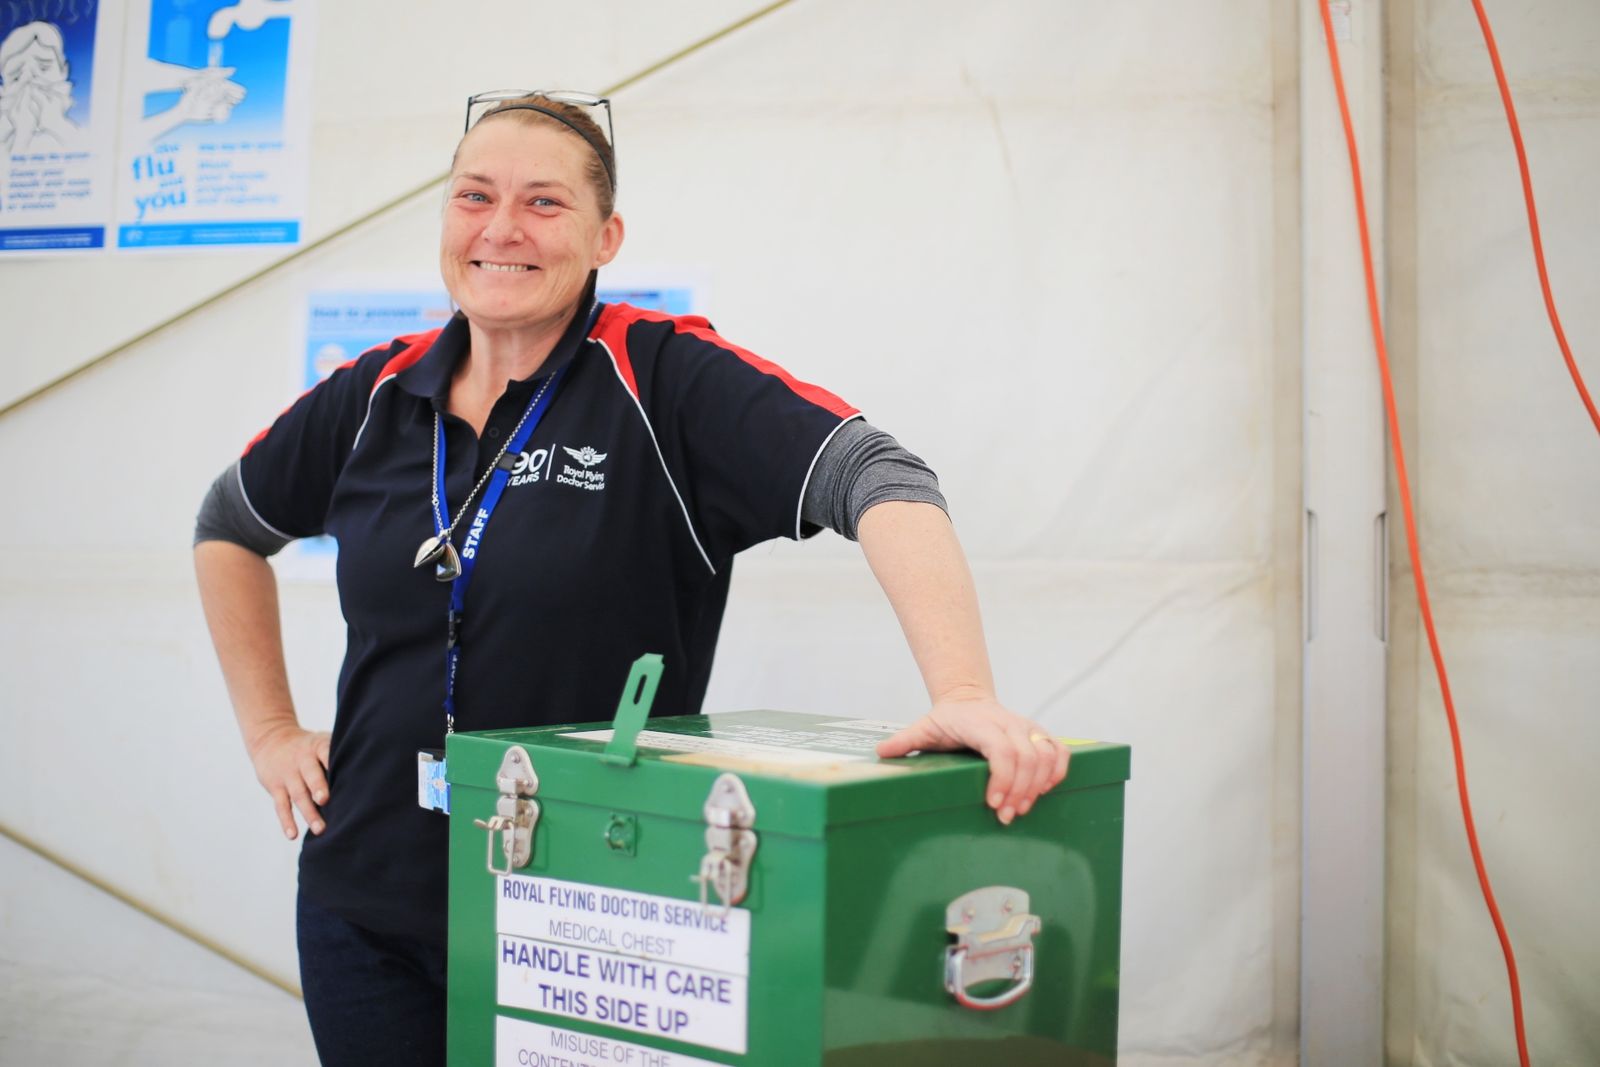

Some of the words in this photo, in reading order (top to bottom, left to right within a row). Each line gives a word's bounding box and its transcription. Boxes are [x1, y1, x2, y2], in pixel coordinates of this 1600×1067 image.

[132, 156, 175, 180] flu
[135, 190, 187, 224] you
[556, 474, 584, 488] Doctor
[563, 465, 585, 479] Royal
[462, 508, 489, 560] STAFF
[503, 879, 545, 905] ROYAL
[549, 886, 596, 912] FLYING
[601, 897, 660, 923] DOCTOR
[664, 904, 729, 934] SERVICE
[549, 919, 617, 947] MEDICAL
[621, 932, 676, 957] CHEST
[502, 939, 591, 979] HANDLE
[597, 957, 657, 991] WITH
[665, 970, 732, 1004] CARE
[538, 983, 588, 1016] THIS
[595, 995, 649, 1028] SIDE
[656, 1005, 690, 1035] UP
[550, 1030, 610, 1060] MISUSE
[613, 1045, 636, 1065] OF
[639, 1050, 672, 1067] THE
